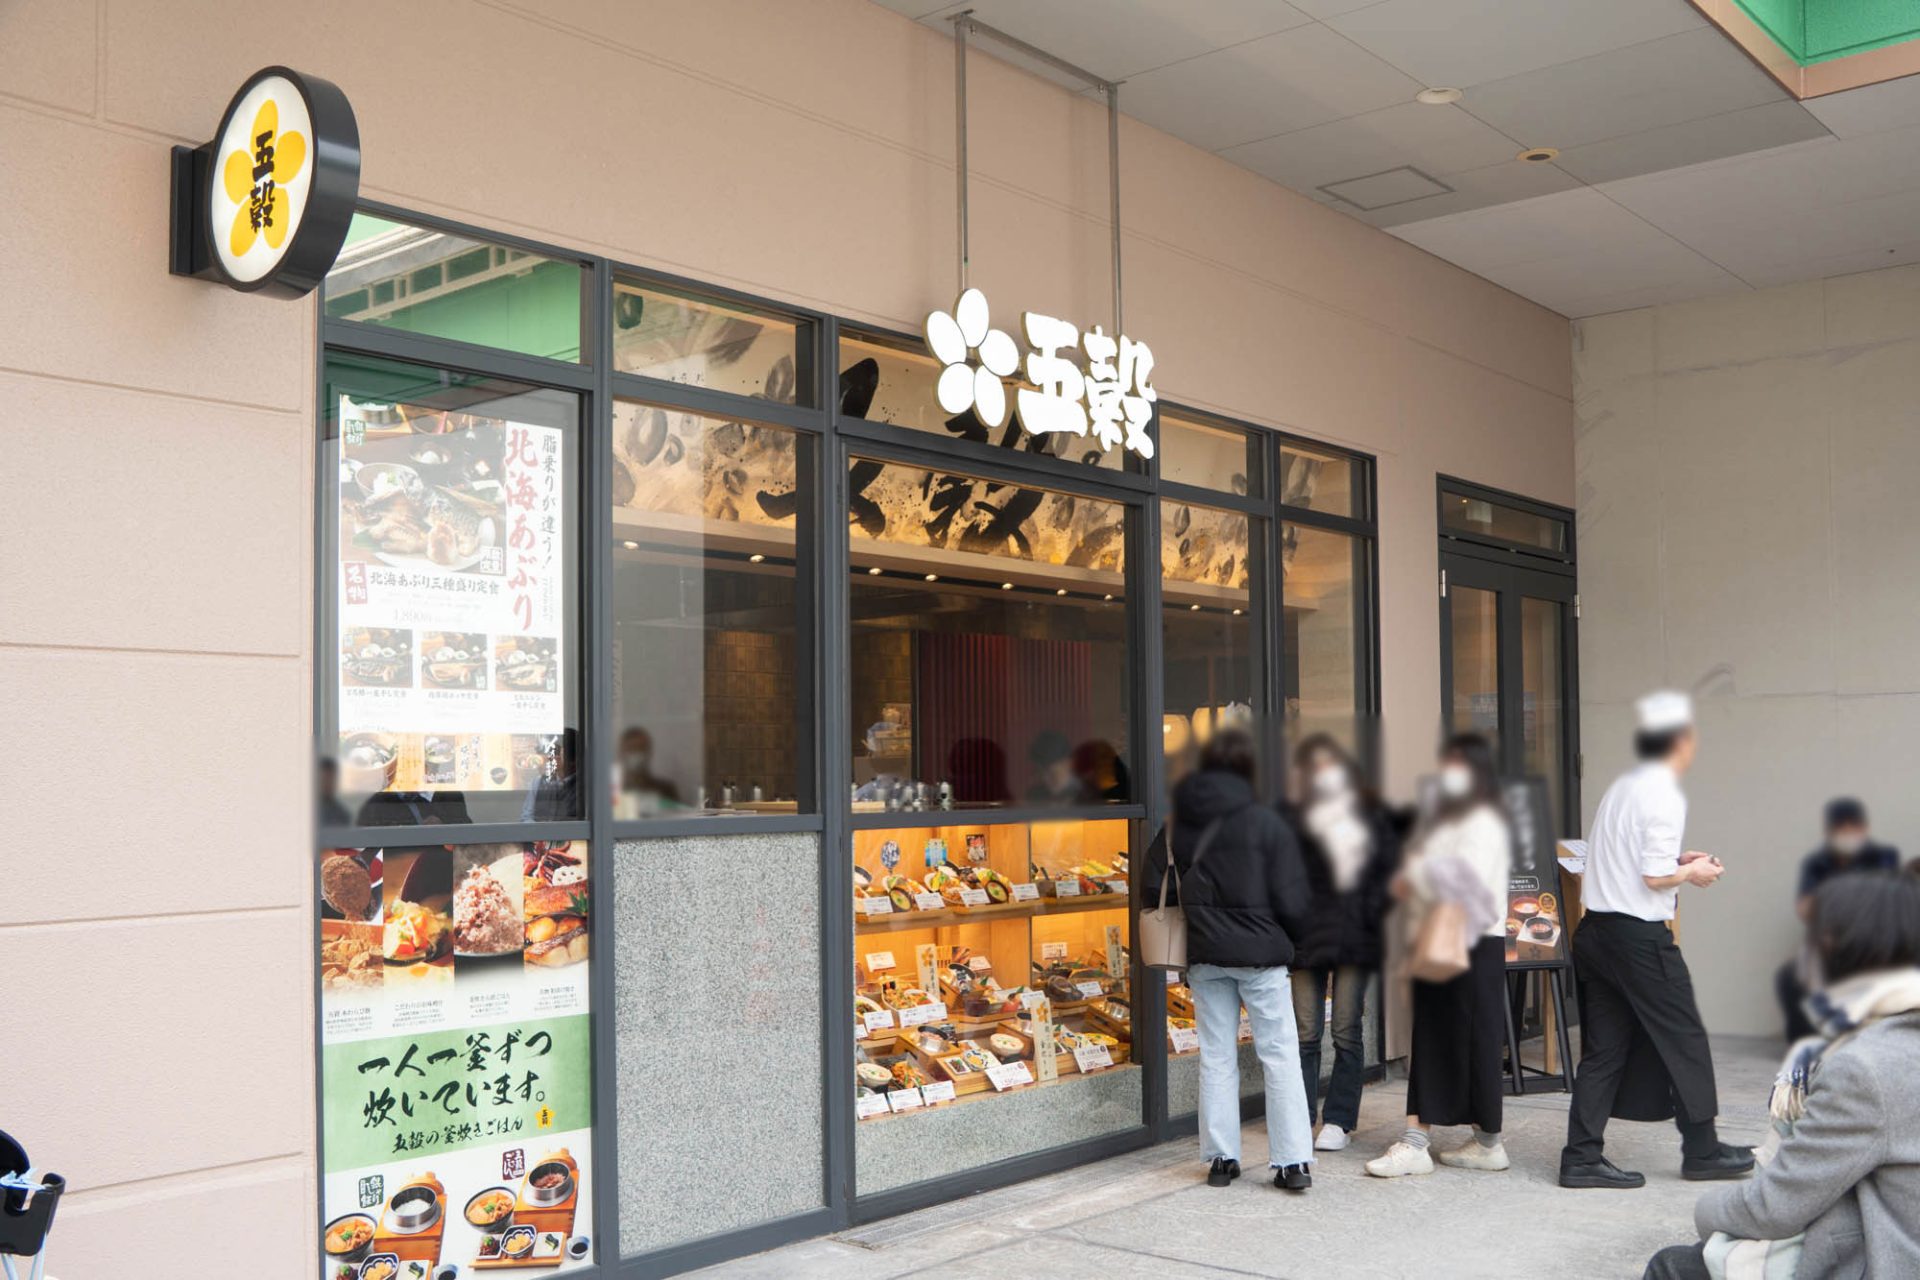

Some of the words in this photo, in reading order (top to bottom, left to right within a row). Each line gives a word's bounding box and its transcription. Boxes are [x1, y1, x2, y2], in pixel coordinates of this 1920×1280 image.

[250, 130, 276, 233] 五穀
[1018, 311, 1157, 460] 五穀
[504, 428, 539, 631] 北海あぶり
[370, 571, 500, 595] 北海あぶり三種盛り定食
[358, 1029, 552, 1078] 一人一釜ずつ
[363, 1070, 545, 1128] 炊いています。
[392, 1116, 523, 1154] 五穀の釜炊きごはん
